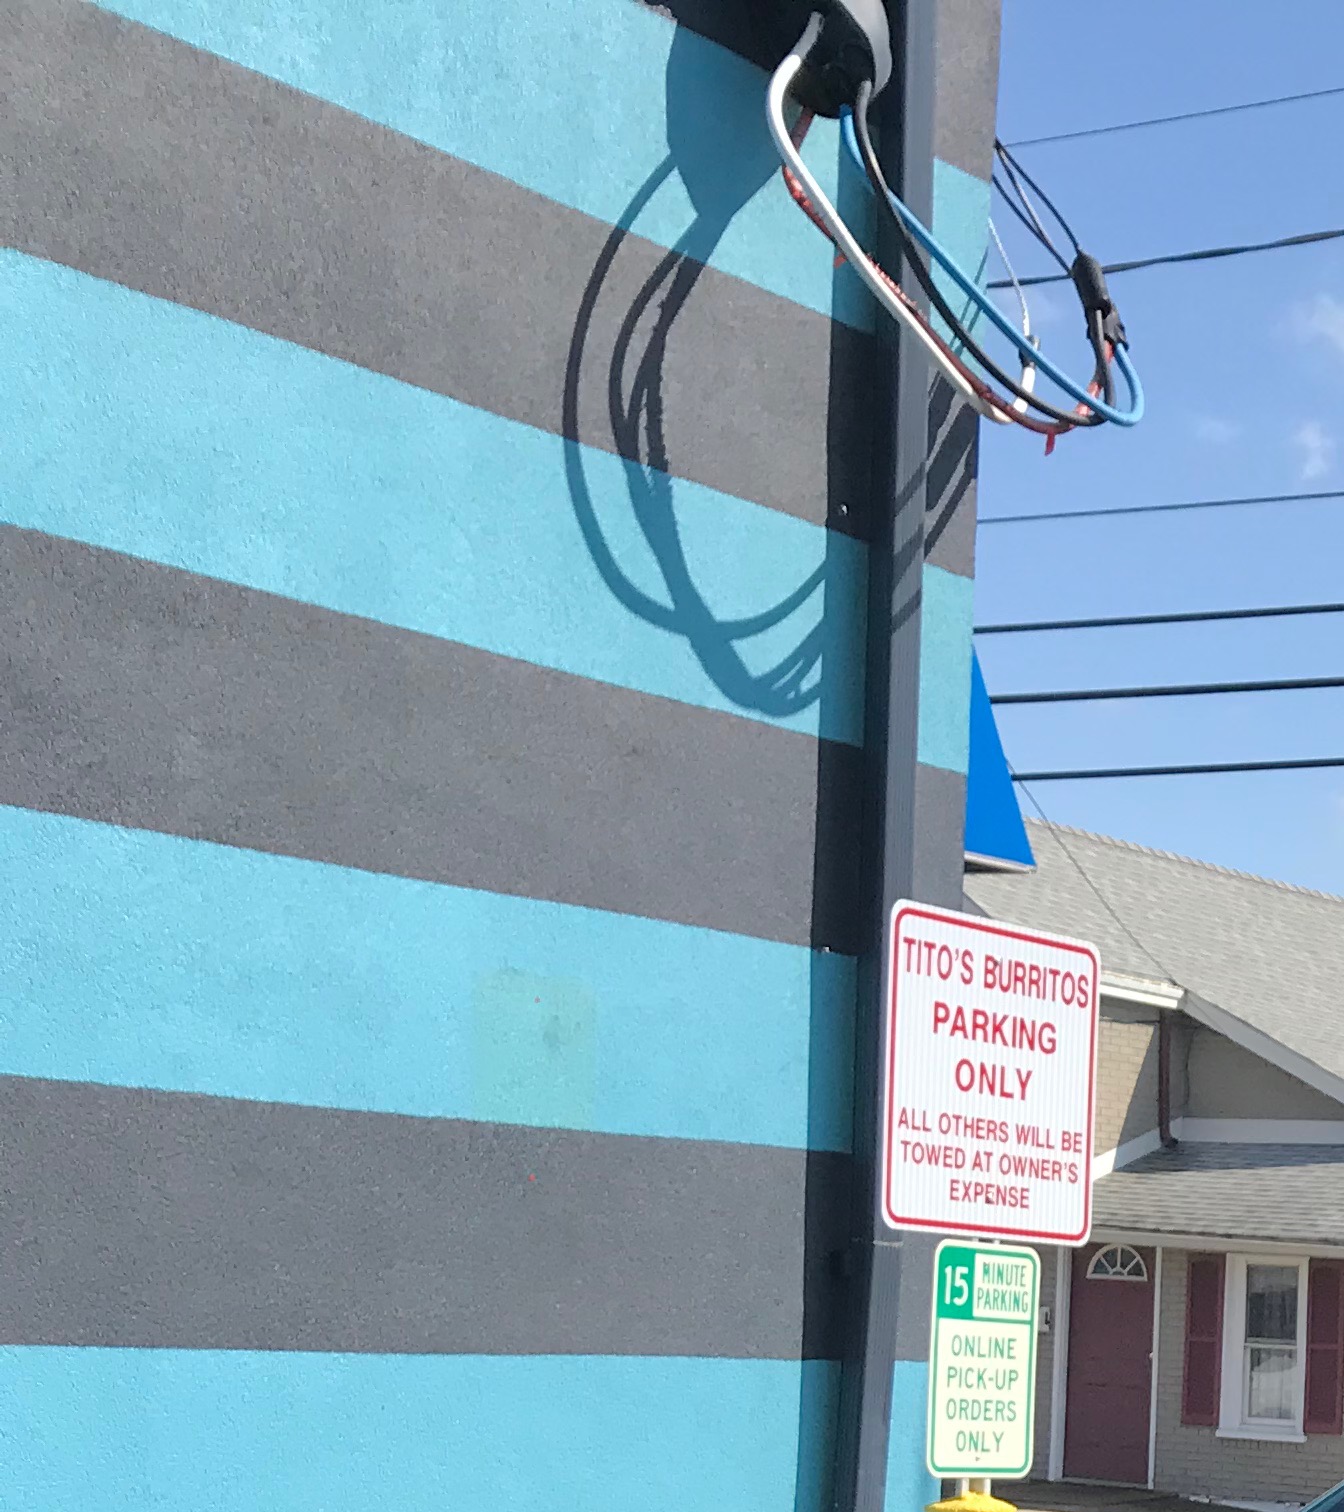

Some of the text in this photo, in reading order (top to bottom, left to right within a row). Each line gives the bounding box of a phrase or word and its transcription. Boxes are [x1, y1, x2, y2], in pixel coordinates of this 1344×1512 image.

[903, 936, 1089, 1009] TITO'S BURRITOS
[933, 1001, 1057, 1054] PARKING
[955, 1059, 1032, 1101] ONLY
[898, 1106, 1082, 1153] ALL OTHERS WILL BE
[901, 1140, 1078, 1184] TOWED AT OWNER'S
[950, 1180, 1029, 1210] EXPENSE
[944, 1265, 969, 1306] 15
[982, 1262, 1027, 1288] MINUTE
[977, 1287, 1028, 1313] PARKING
[951, 1335, 1017, 1360] ONLINE
[947, 1366, 1018, 1390] PICK-UP
[946, 1398, 1016, 1422] ORDERS
[956, 1430, 1004, 1453] ONLY
